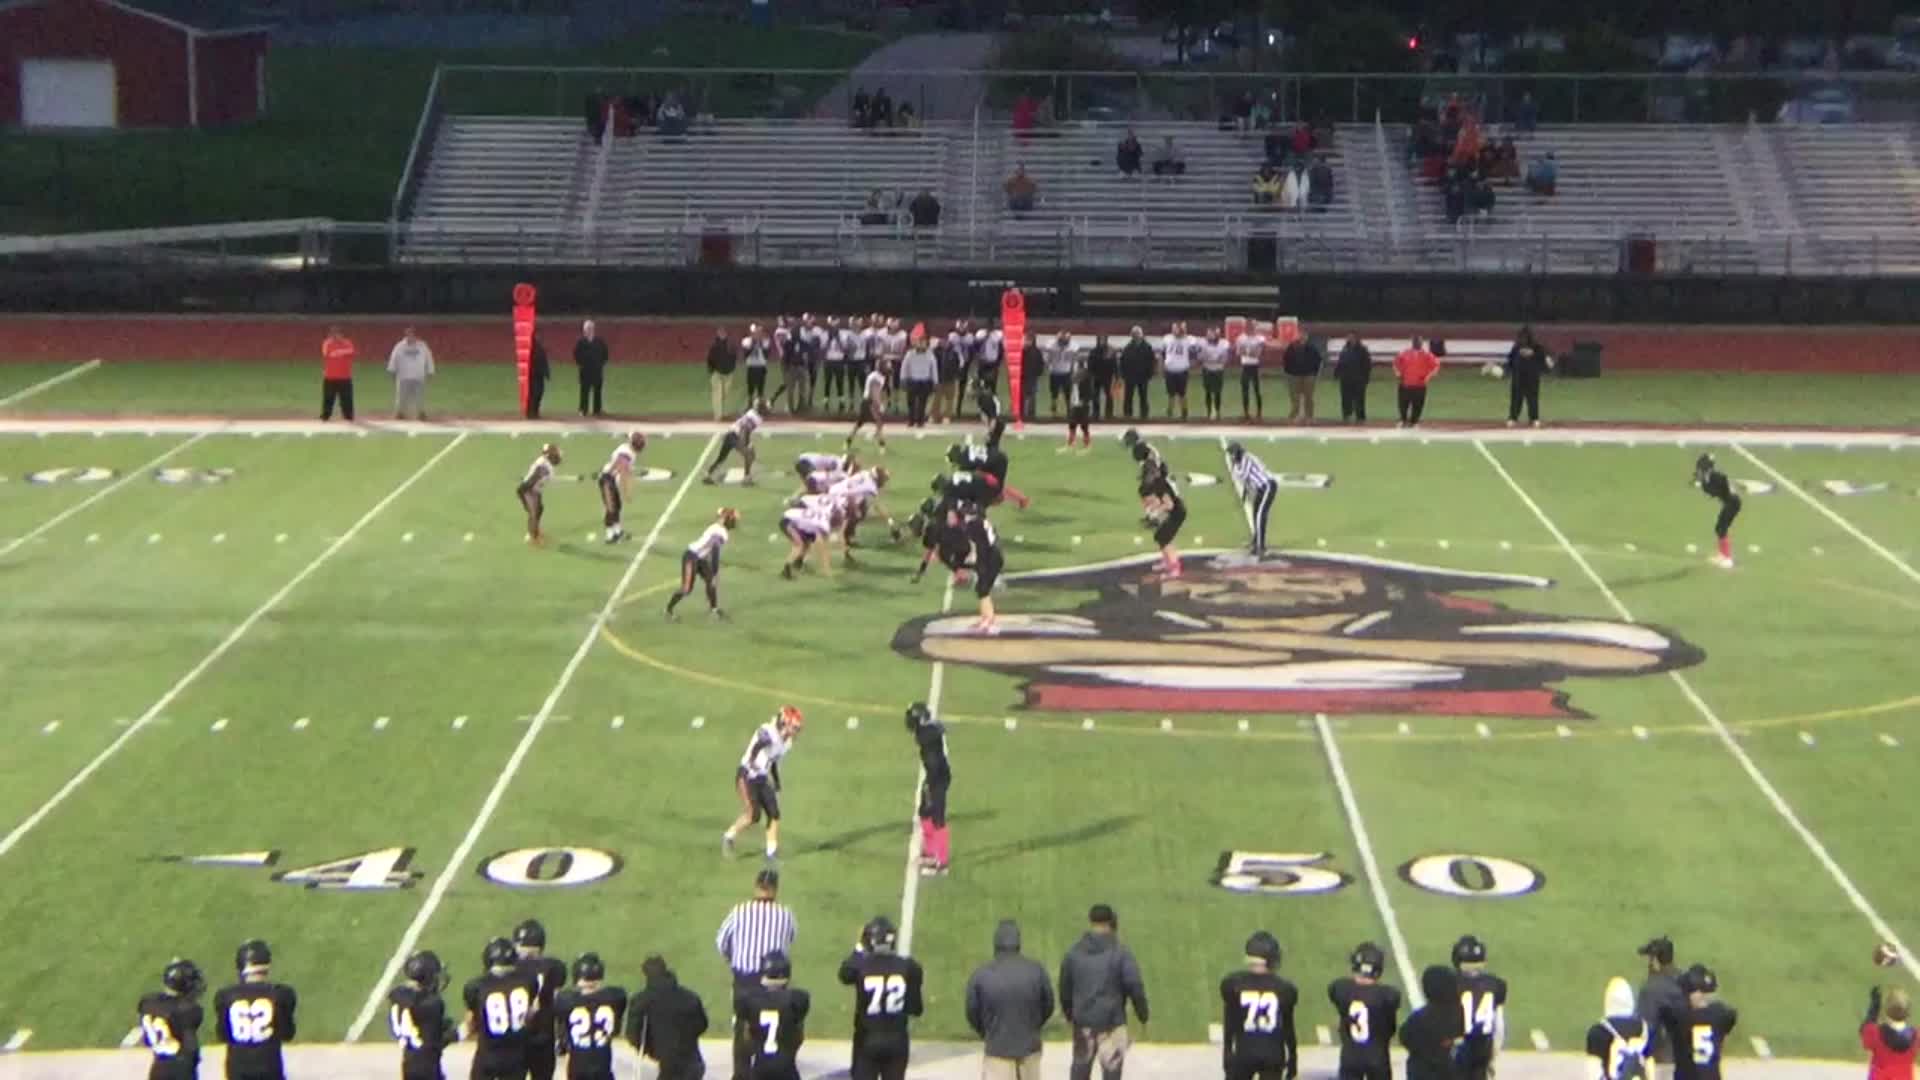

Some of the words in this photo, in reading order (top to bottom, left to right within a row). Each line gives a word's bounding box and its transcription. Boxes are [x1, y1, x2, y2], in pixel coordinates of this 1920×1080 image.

[485, 986, 530, 1034] 88
[863, 974, 907, 1015] 72
[1239, 990, 1279, 1033] 73
[1460, 991, 1495, 1034] 14
[228, 998, 274, 1043] 62
[569, 1005, 615, 1047] 23
[759, 1010, 779, 1054] 7
[1350, 1000, 1369, 1042] 3
[1692, 1024, 1715, 1064] 5
